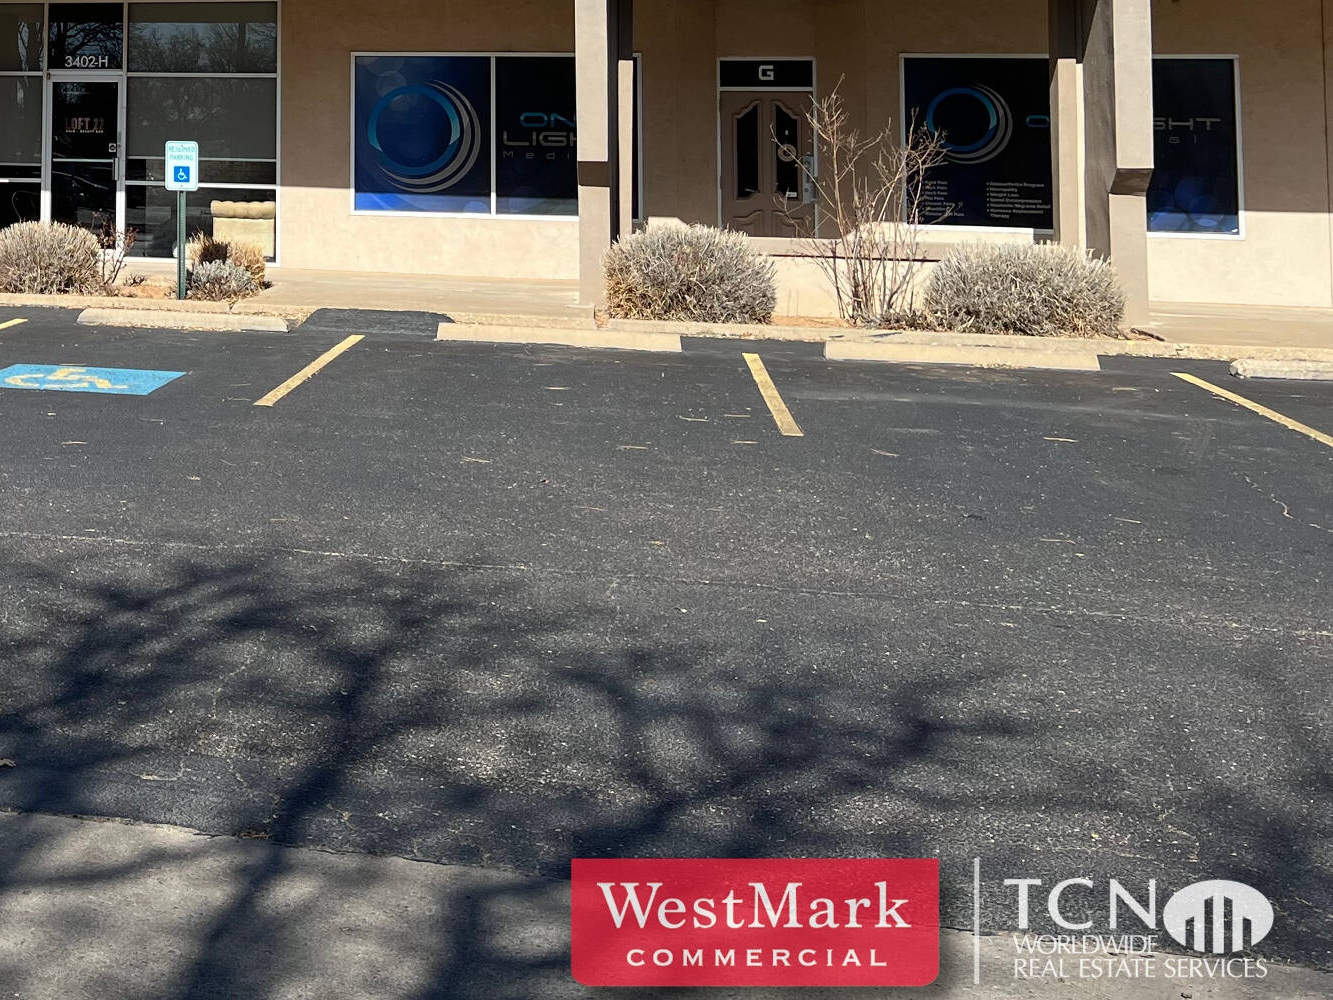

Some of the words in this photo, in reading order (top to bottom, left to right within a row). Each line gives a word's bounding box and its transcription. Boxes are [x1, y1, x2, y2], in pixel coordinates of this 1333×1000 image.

[64, 55, 108, 68] 3402-H
[758, 65, 775, 81] G
[520, 112, 576, 128] ON
